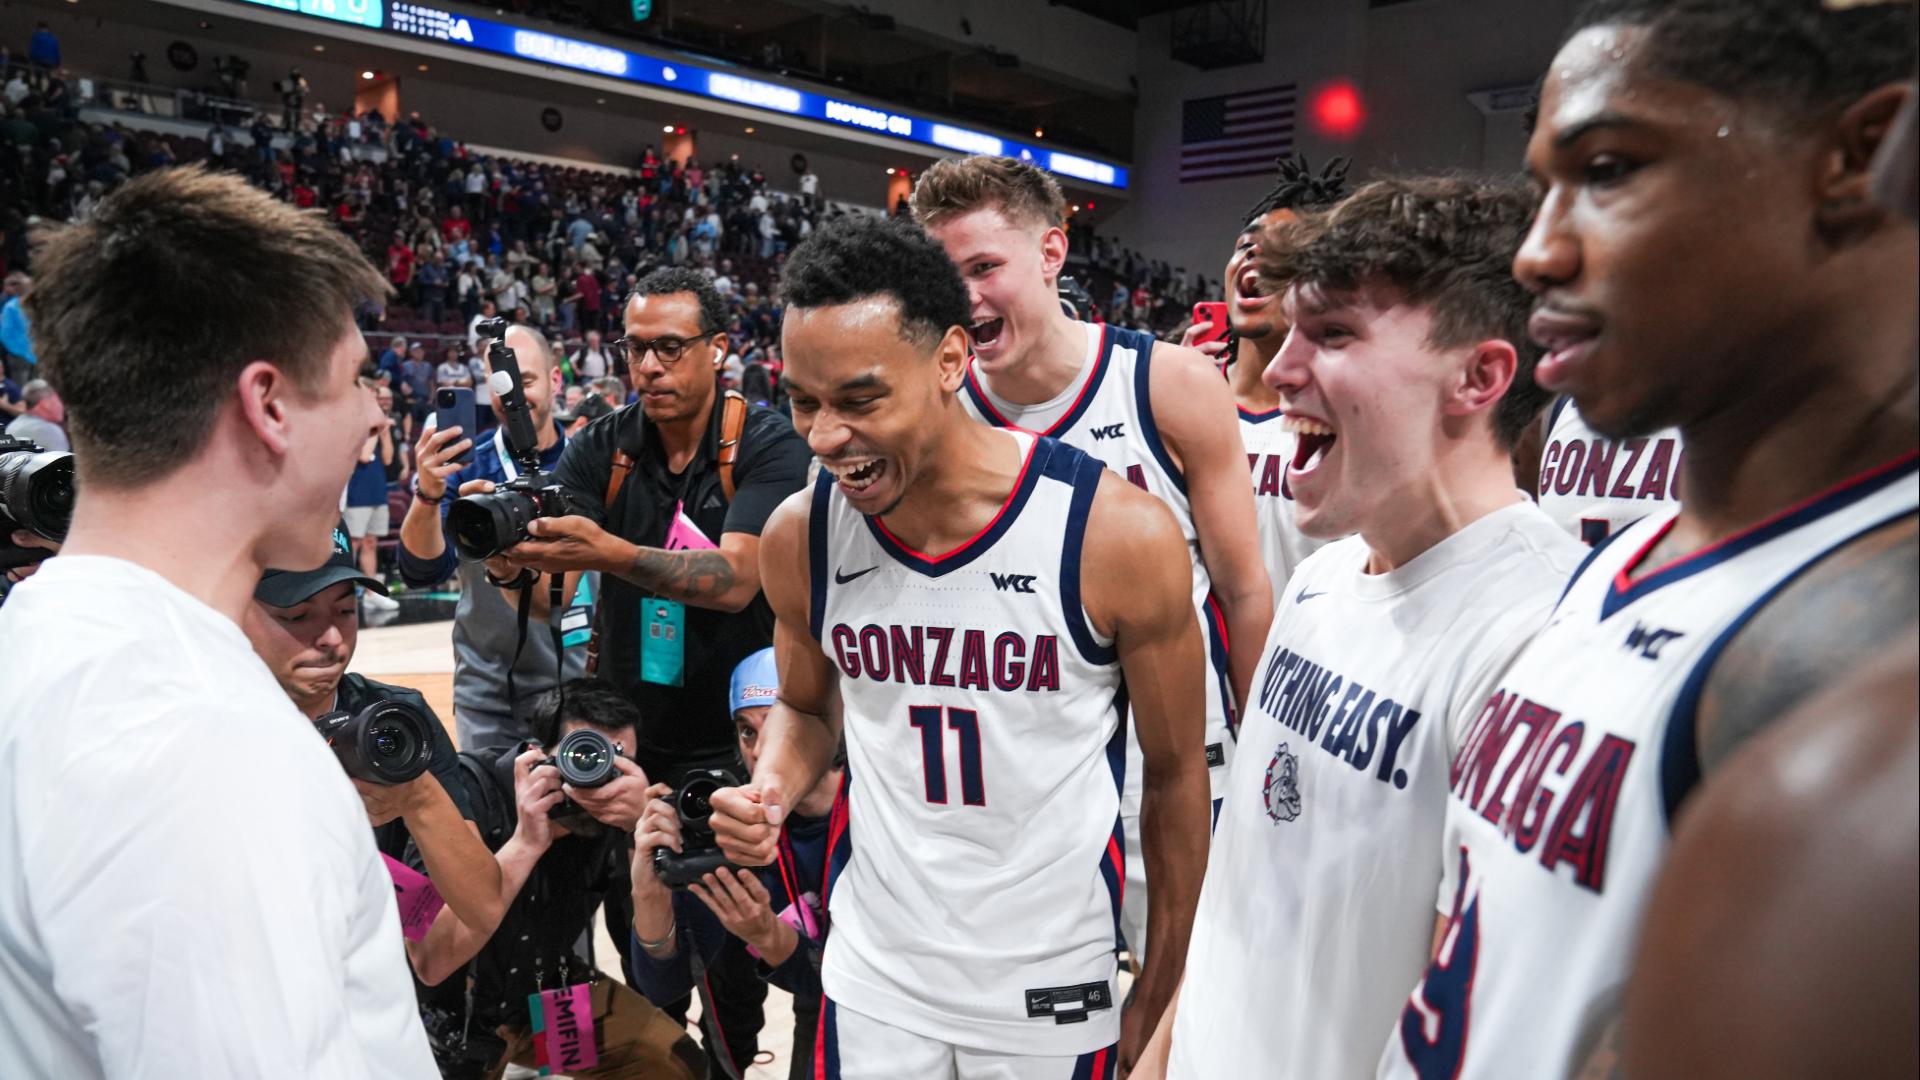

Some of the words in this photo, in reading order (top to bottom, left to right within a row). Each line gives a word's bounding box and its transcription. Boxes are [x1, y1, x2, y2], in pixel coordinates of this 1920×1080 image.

[888, 115, 911, 136] ON
[1090, 422, 1125, 441] WCC
[990, 572, 1037, 593] WCC
[831, 623, 1060, 692] GONZAGA
[908, 705, 986, 807] 11
[1320, 681, 1422, 790] EASY.
[1088, 990, 1101, 1002] 46
[553, 986, 582, 1073] EMIFIN
